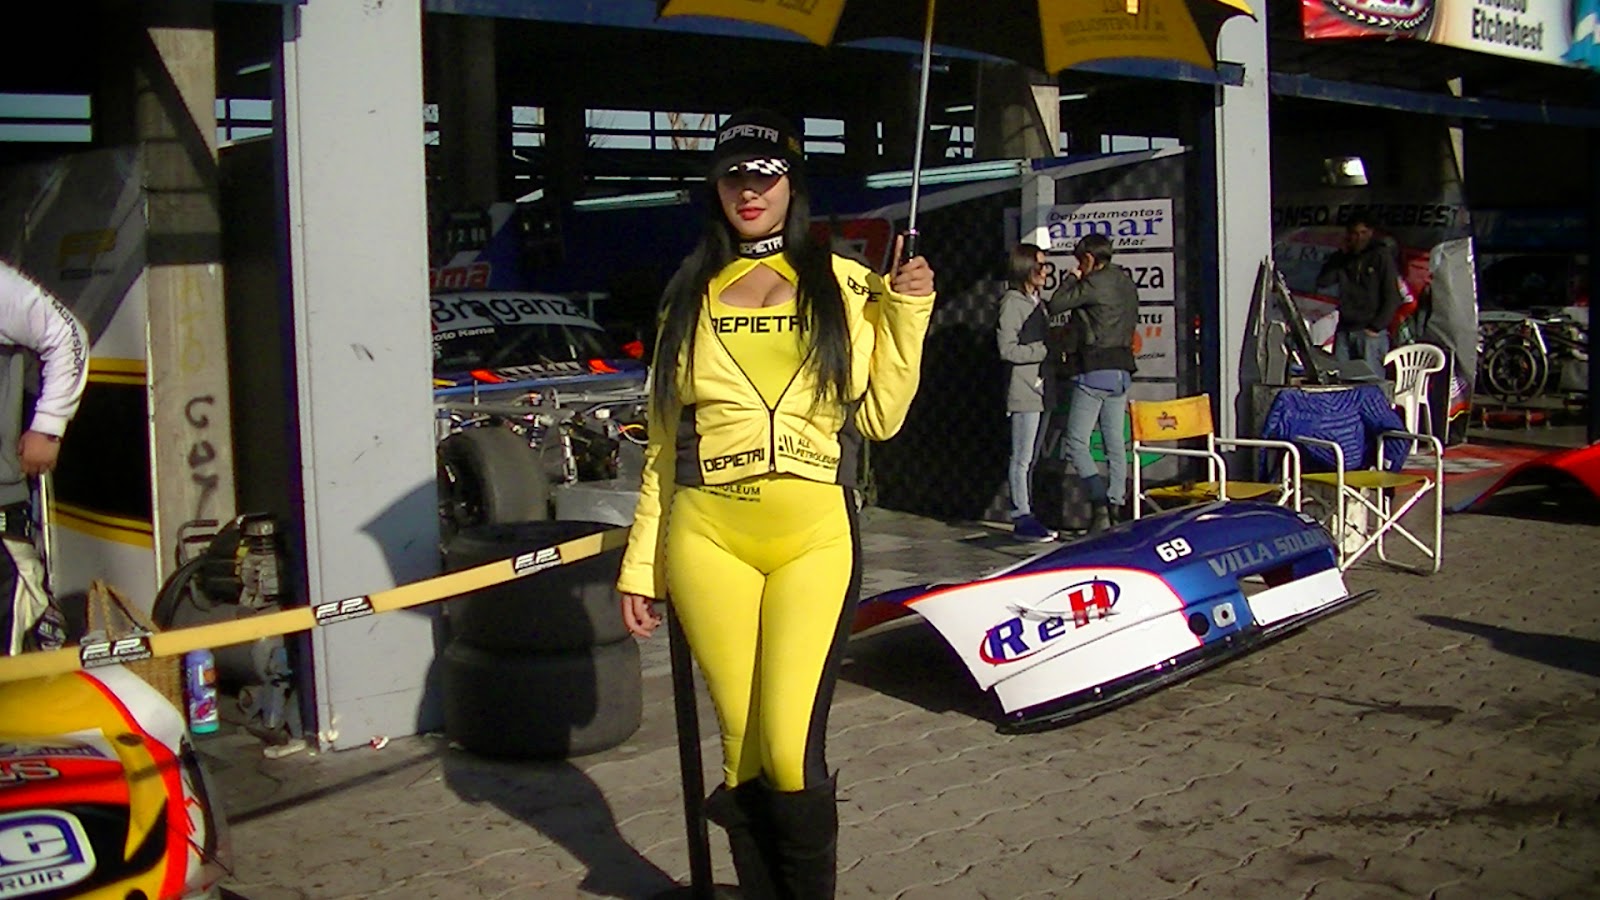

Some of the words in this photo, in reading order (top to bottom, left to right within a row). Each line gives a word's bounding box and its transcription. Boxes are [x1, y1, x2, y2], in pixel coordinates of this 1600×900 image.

[1472, 8, 1544, 50] Etchebest
[718, 124, 779, 145] DEPIETRI
[1050, 208, 1164, 222] Departamentos
[703, 447, 765, 473] DEPIETRI
[1156, 537, 1193, 562] 69
[1207, 543, 1274, 577] VILLA
